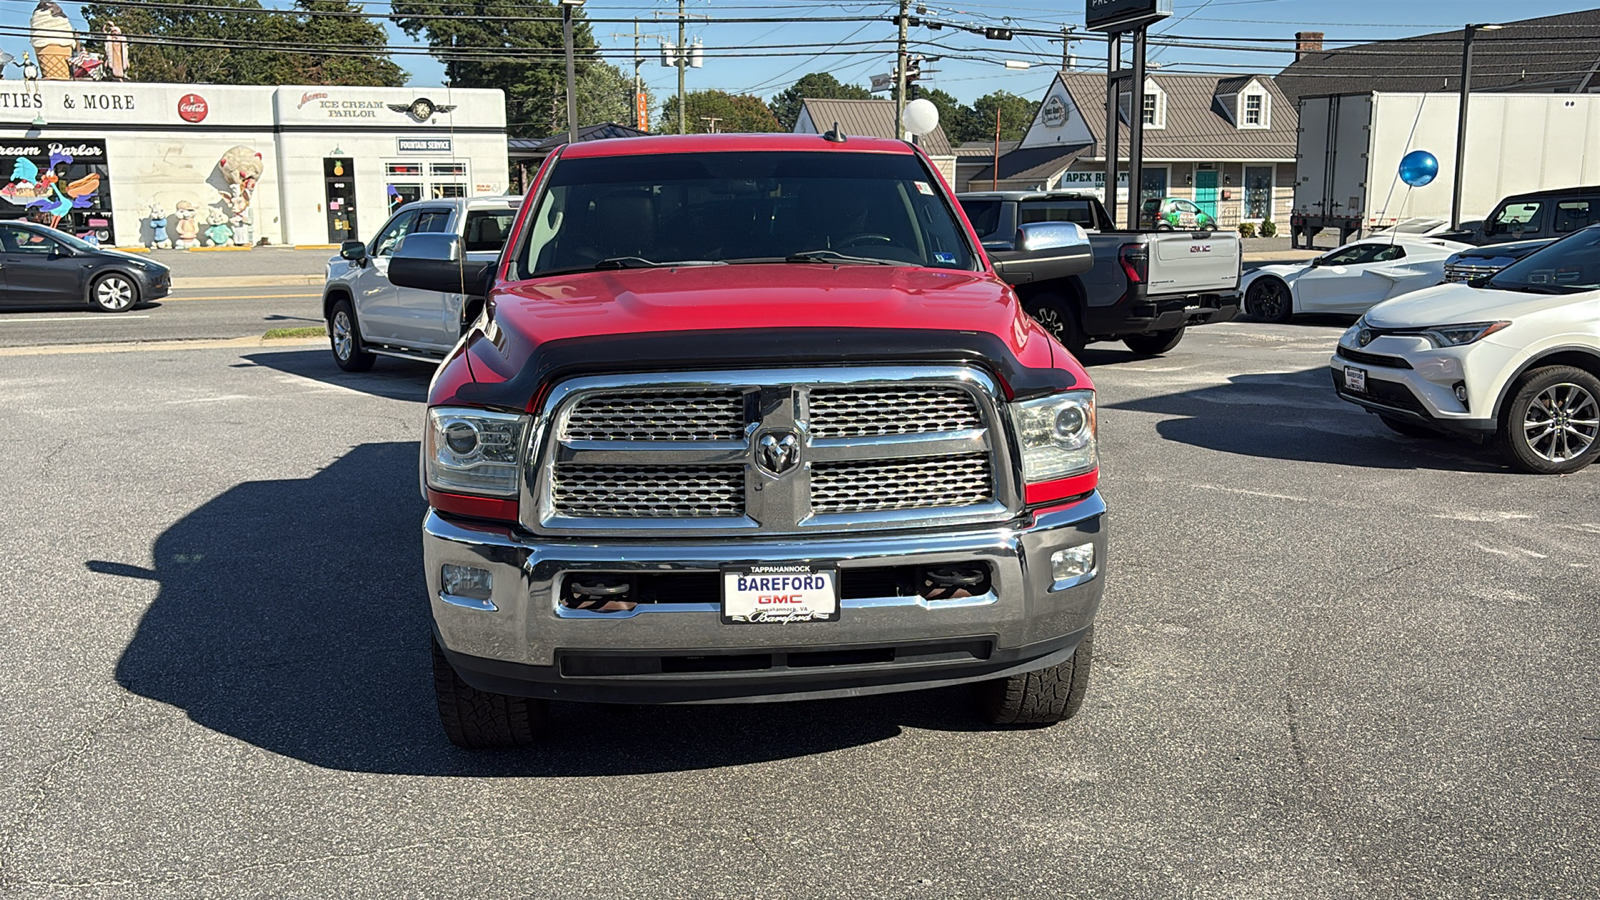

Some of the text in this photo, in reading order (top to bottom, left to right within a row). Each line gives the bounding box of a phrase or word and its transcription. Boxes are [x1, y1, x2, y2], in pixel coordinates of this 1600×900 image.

[63, 94, 75, 109] &
[83, 94, 135, 110] MORE
[48, 143, 102, 156] Parlor
[400, 141, 450, 149] FOUNTAIN SERVICE
[1066, 173, 1092, 182] APEX
[737, 577, 825, 591] BAREFORD
[758, 594, 803, 604] GMC
[749, 610, 815, 625] Bareford
